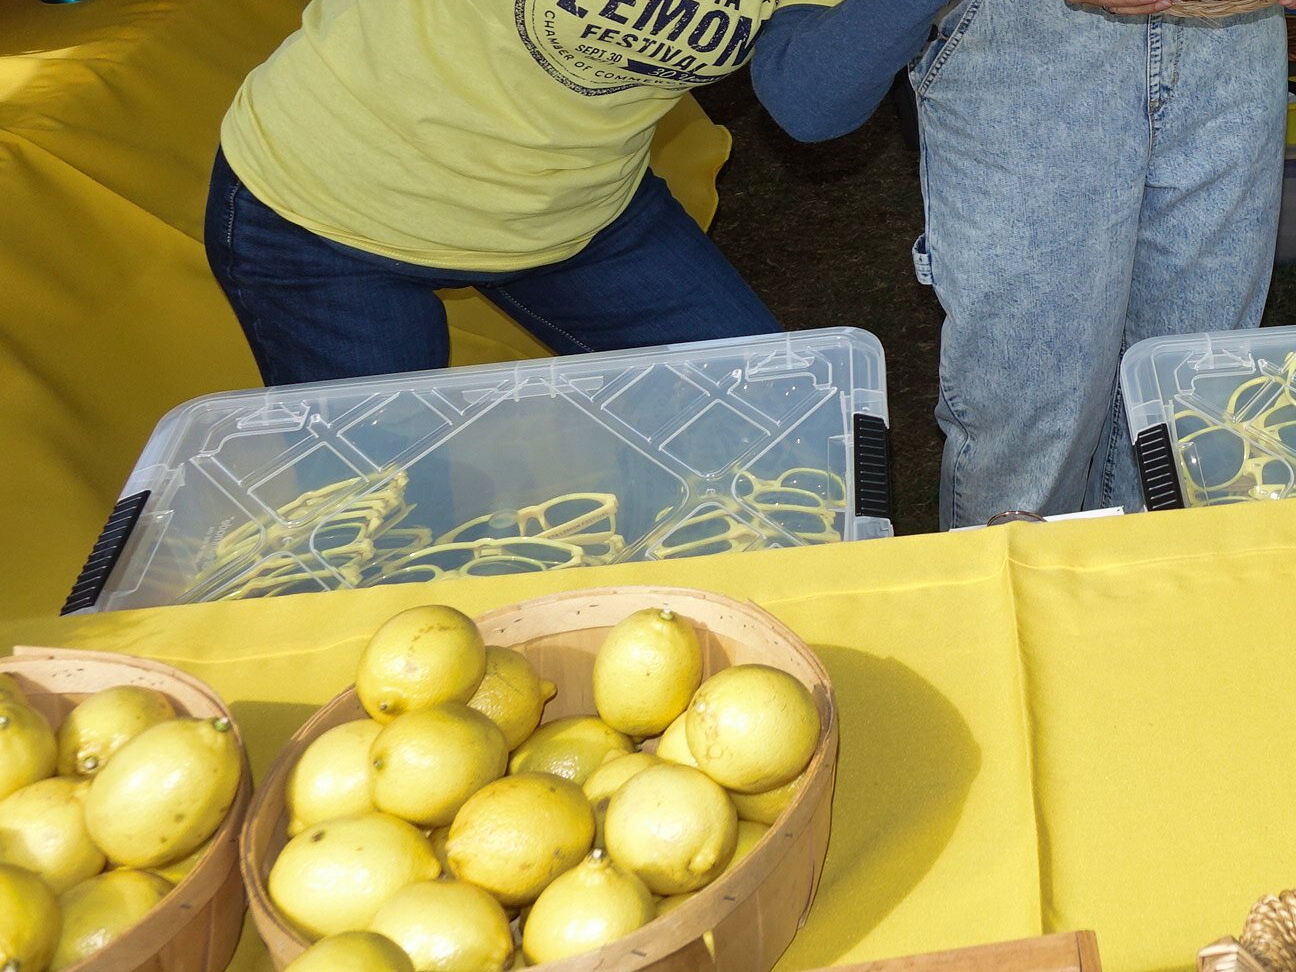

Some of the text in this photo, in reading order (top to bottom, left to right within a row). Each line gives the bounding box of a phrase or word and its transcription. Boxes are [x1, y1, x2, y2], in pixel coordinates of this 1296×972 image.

[543, 10, 573, 61] CHAMBER
[574, 60, 593, 74] OF
[574, 44, 607, 60] SEPT
[606, 52, 623, 63] 30
[580, 23, 708, 74] FESTIVAL
